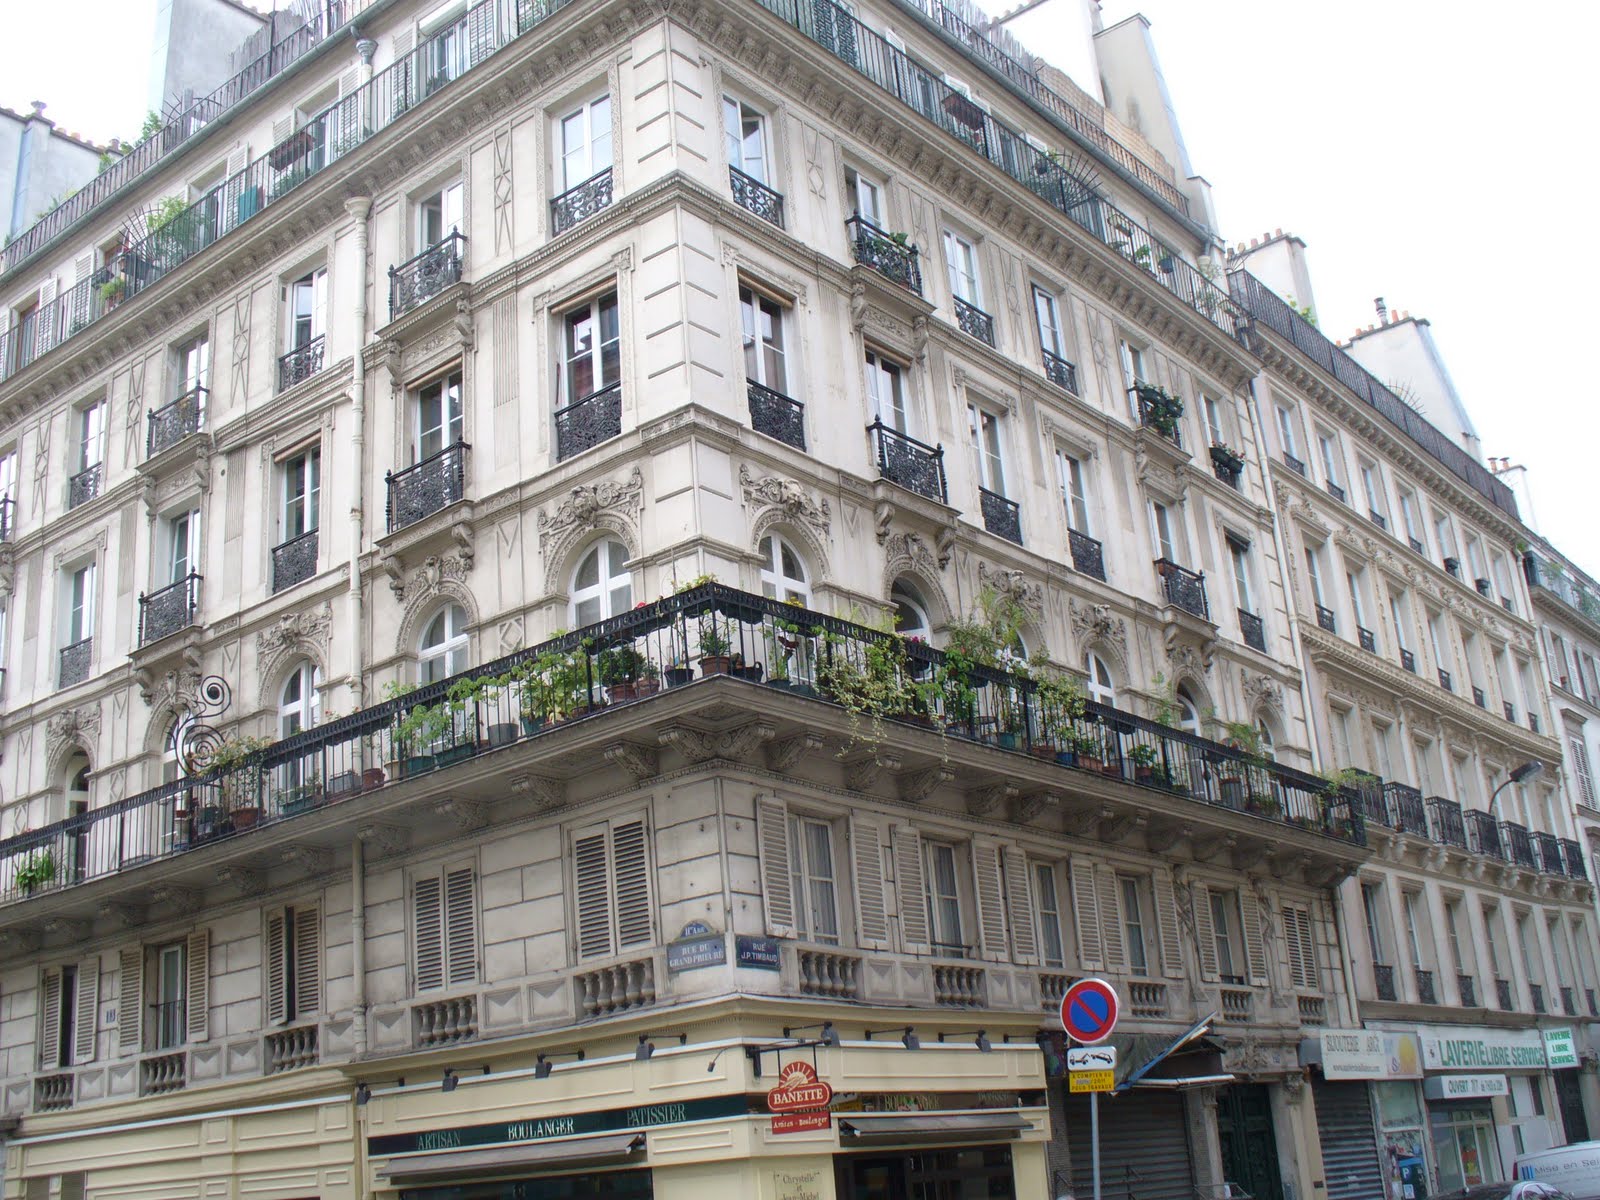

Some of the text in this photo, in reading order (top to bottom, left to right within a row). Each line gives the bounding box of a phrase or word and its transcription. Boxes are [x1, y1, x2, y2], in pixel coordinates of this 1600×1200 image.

[682, 944, 710, 956] RUE DU
[752, 943, 766, 952] RUE
[669, 956, 693, 968] GRAND
[1545, 1030, 1571, 1041] LAVERIE
[1438, 1039, 1487, 1067] LAVERIE
[1485, 1046, 1511, 1066] LIBRE
[1511, 1046, 1545, 1066] SERVICE
[1552, 1043, 1569, 1053] LIBRE
[1550, 1055, 1575, 1065] SERVICE
[1448, 1079, 1469, 1094] OUVERT
[773, 1088, 824, 1105] BANETTE
[627, 1103, 687, 1128] PATISSIER
[799, 1115, 828, 1127] Boulanger
[508, 1117, 575, 1141] BOULANGER
[417, 1130, 462, 1151] ARTISAN
[1563, 1161, 1579, 1170] en
